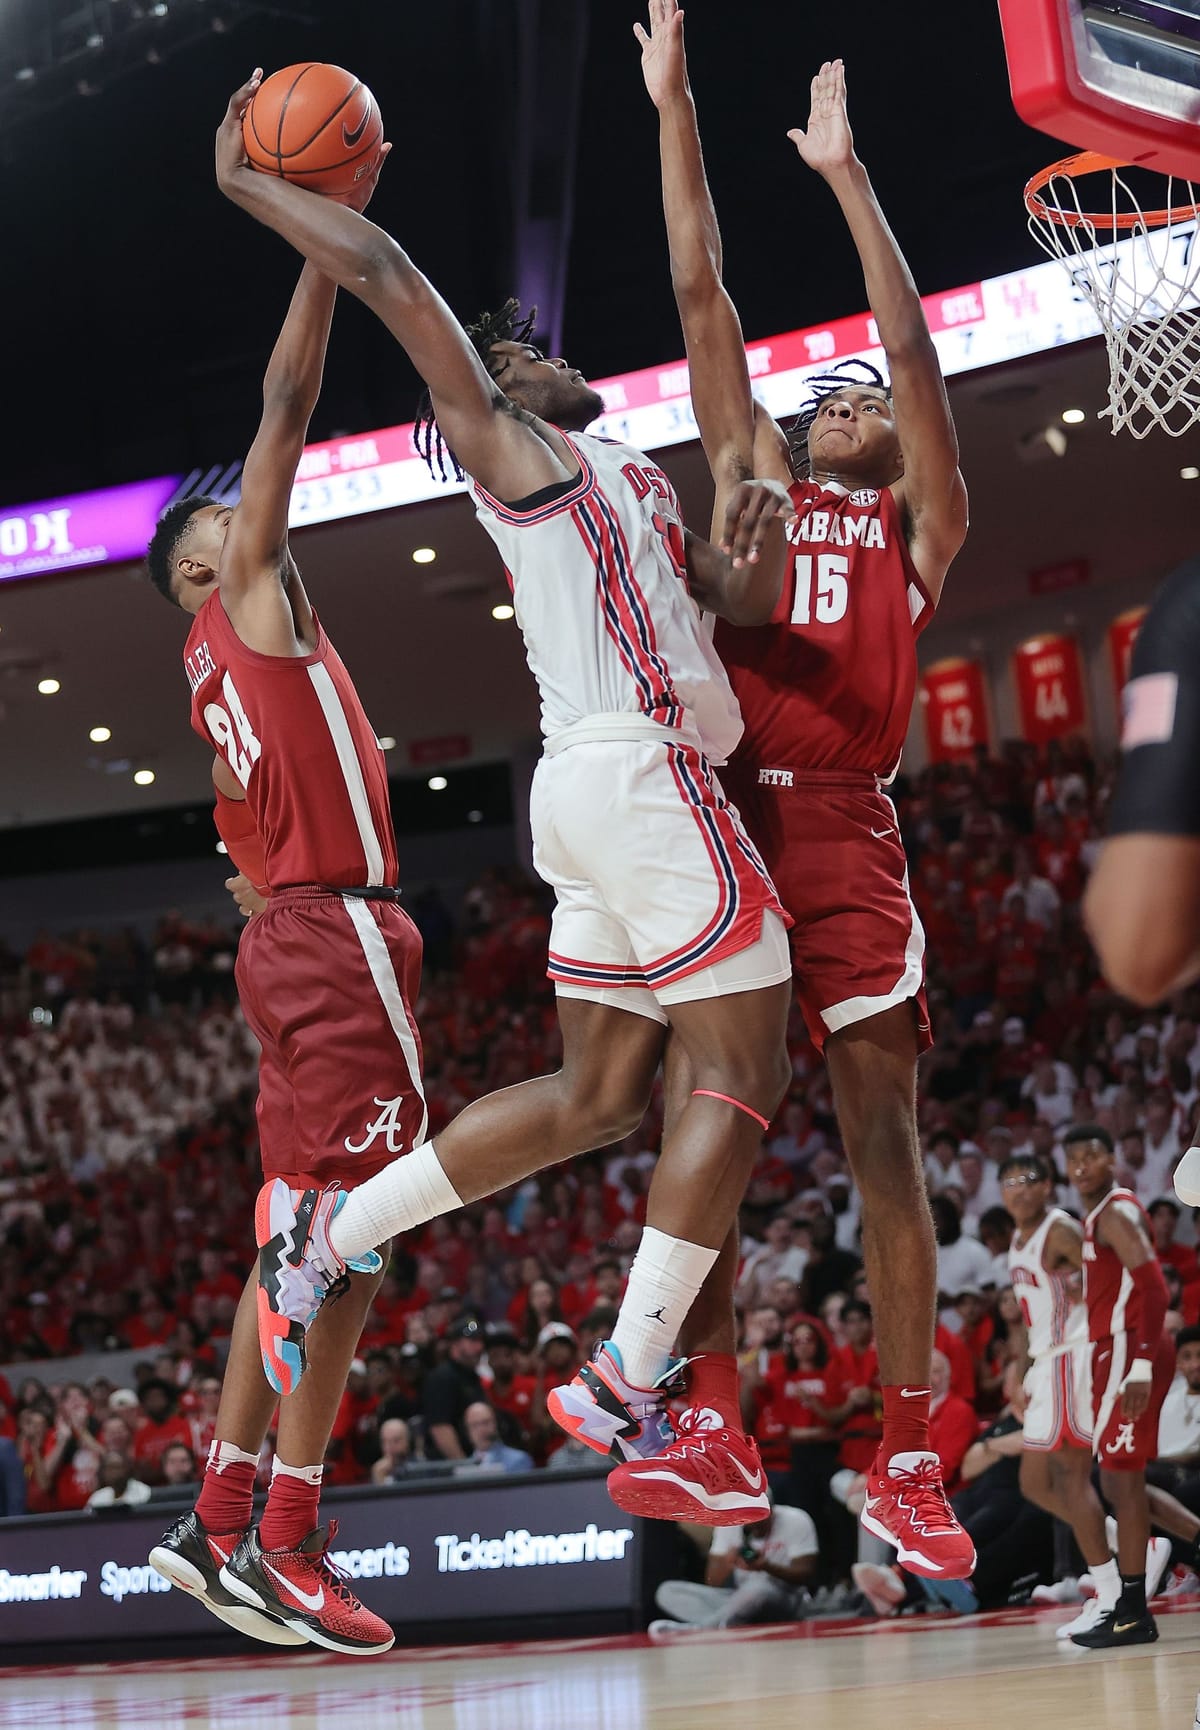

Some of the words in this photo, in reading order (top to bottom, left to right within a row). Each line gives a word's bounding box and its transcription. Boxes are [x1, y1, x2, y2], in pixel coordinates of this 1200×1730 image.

[851, 489, 878, 506] SEC
[785, 511, 886, 549] ABAMA
[791, 554, 849, 625] 15
[204, 669, 262, 791] 24
[758, 768, 794, 787] RTR
[344, 1095, 404, 1153] A
[326, 1541, 410, 1578] ncerts
[434, 1523, 635, 1573] TicketSmarter
